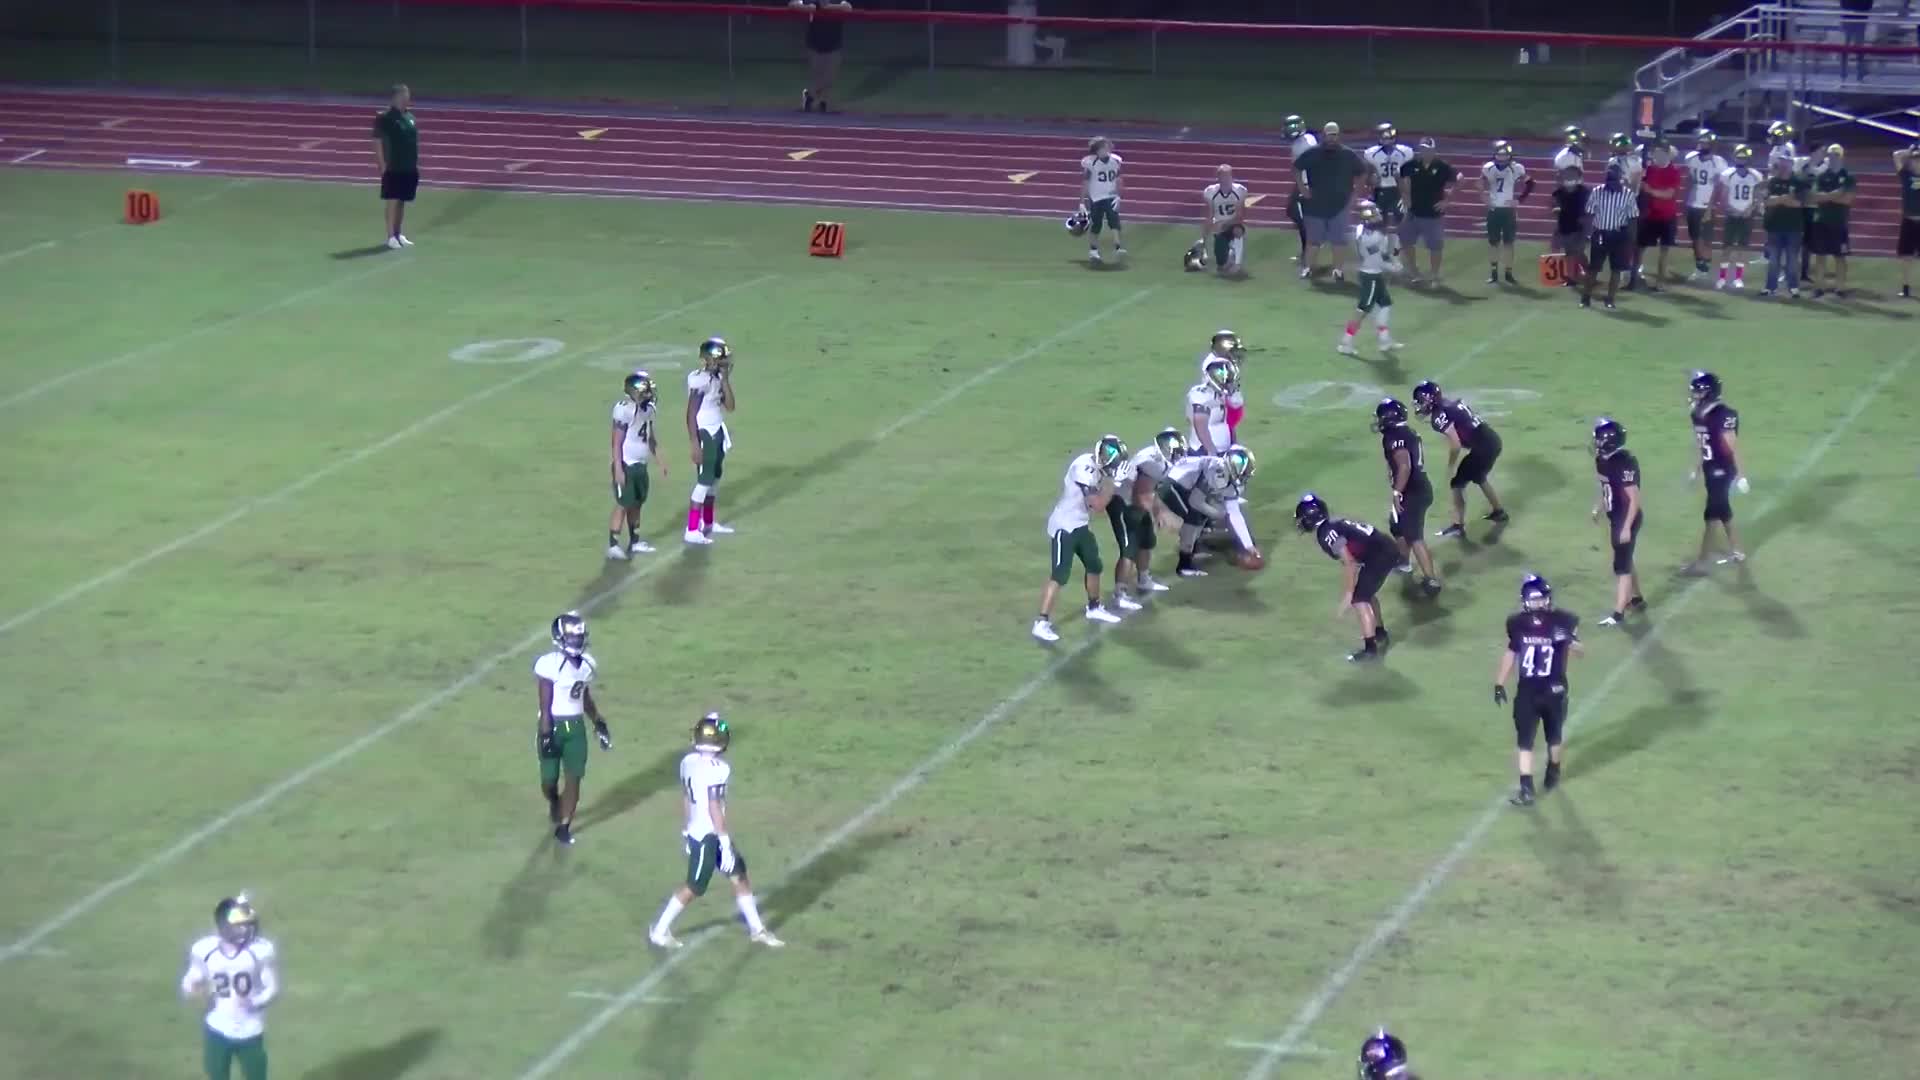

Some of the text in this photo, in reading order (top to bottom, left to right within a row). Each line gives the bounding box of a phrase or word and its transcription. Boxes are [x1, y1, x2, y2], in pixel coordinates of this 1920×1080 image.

[1694, 168, 1708, 185] 19
[1735, 184, 1750, 200] 18
[128, 192, 151, 218] 10
[811, 223, 839, 248] 20
[1544, 255, 1569, 281] 30
[638, 420, 648, 443] 4
[1522, 645, 1555, 677] 43
[213, 972, 251, 998] 20
